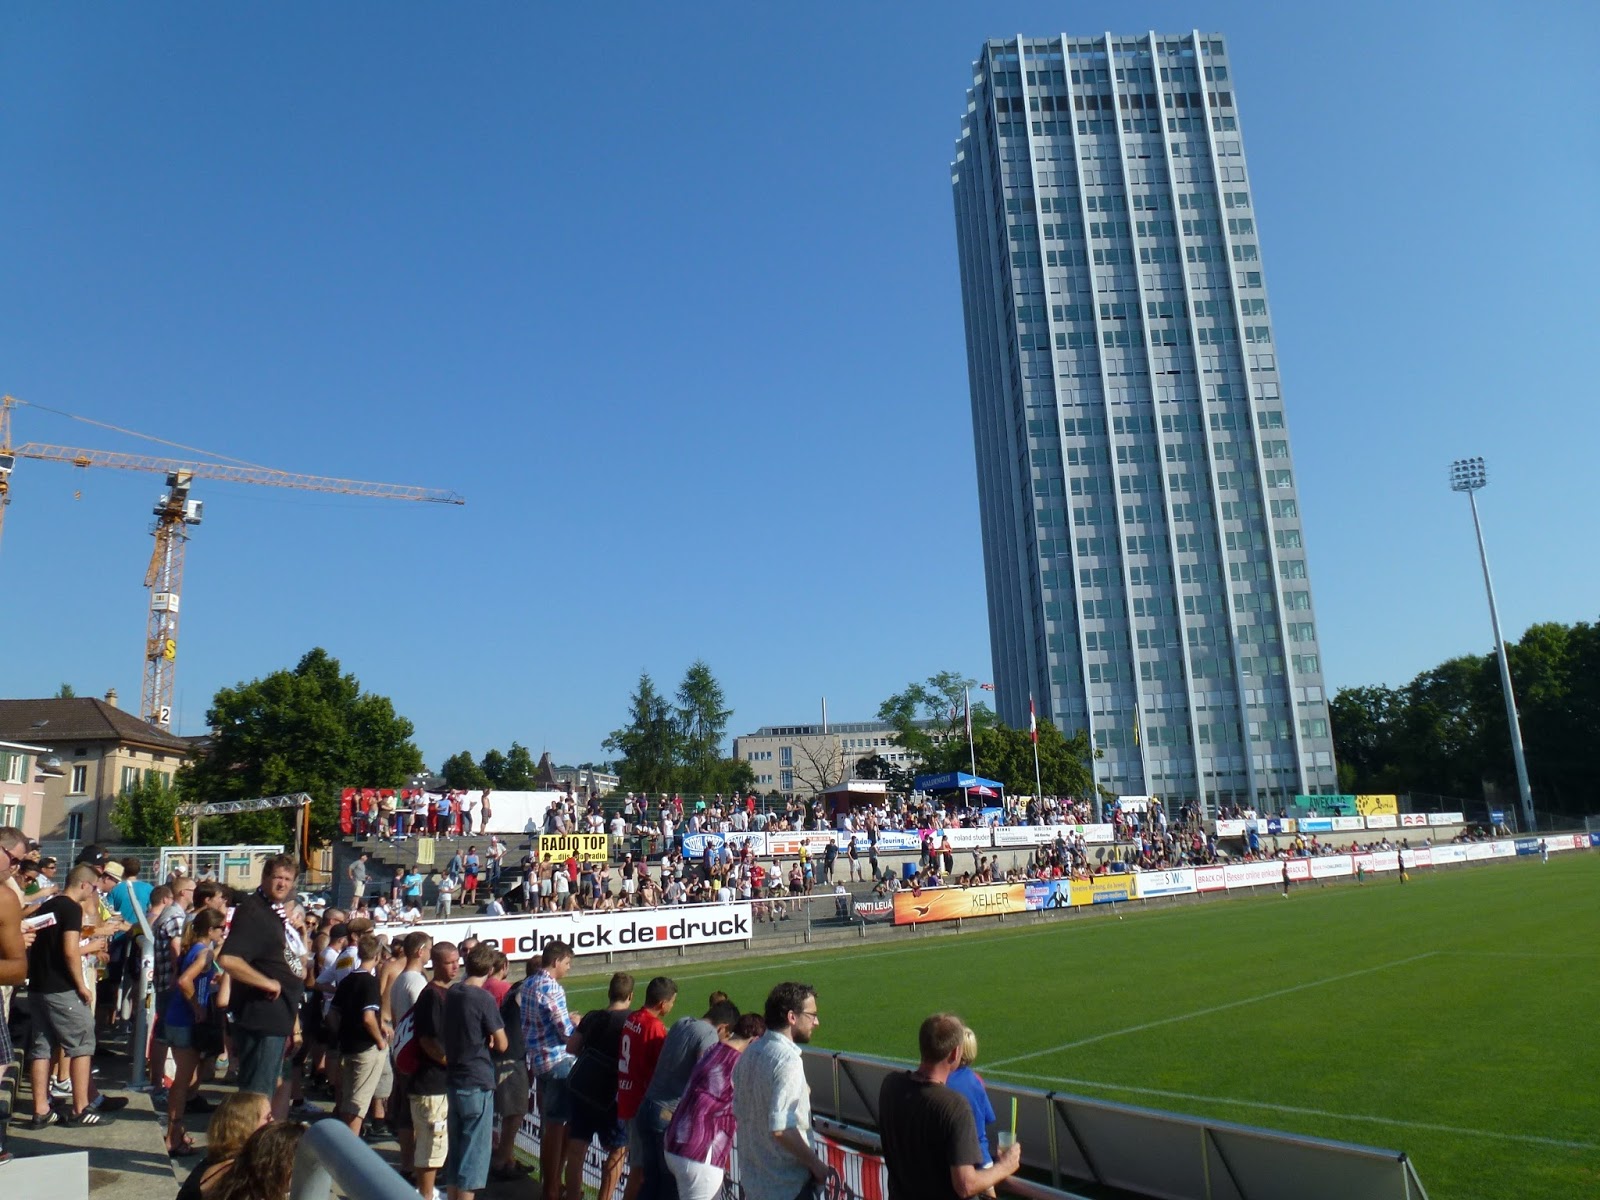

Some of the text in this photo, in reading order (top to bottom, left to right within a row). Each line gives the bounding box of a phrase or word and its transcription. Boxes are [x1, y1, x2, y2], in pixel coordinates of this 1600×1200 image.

[162, 708, 170, 721] 2
[541, 836, 606, 851] RADIO TOP
[882, 837, 905, 846] Touring
[971, 892, 1009, 907] KELLER
[619, 921, 654, 945] de
[669, 913, 749, 940] druck
[618, 1034, 631, 1074] 9
